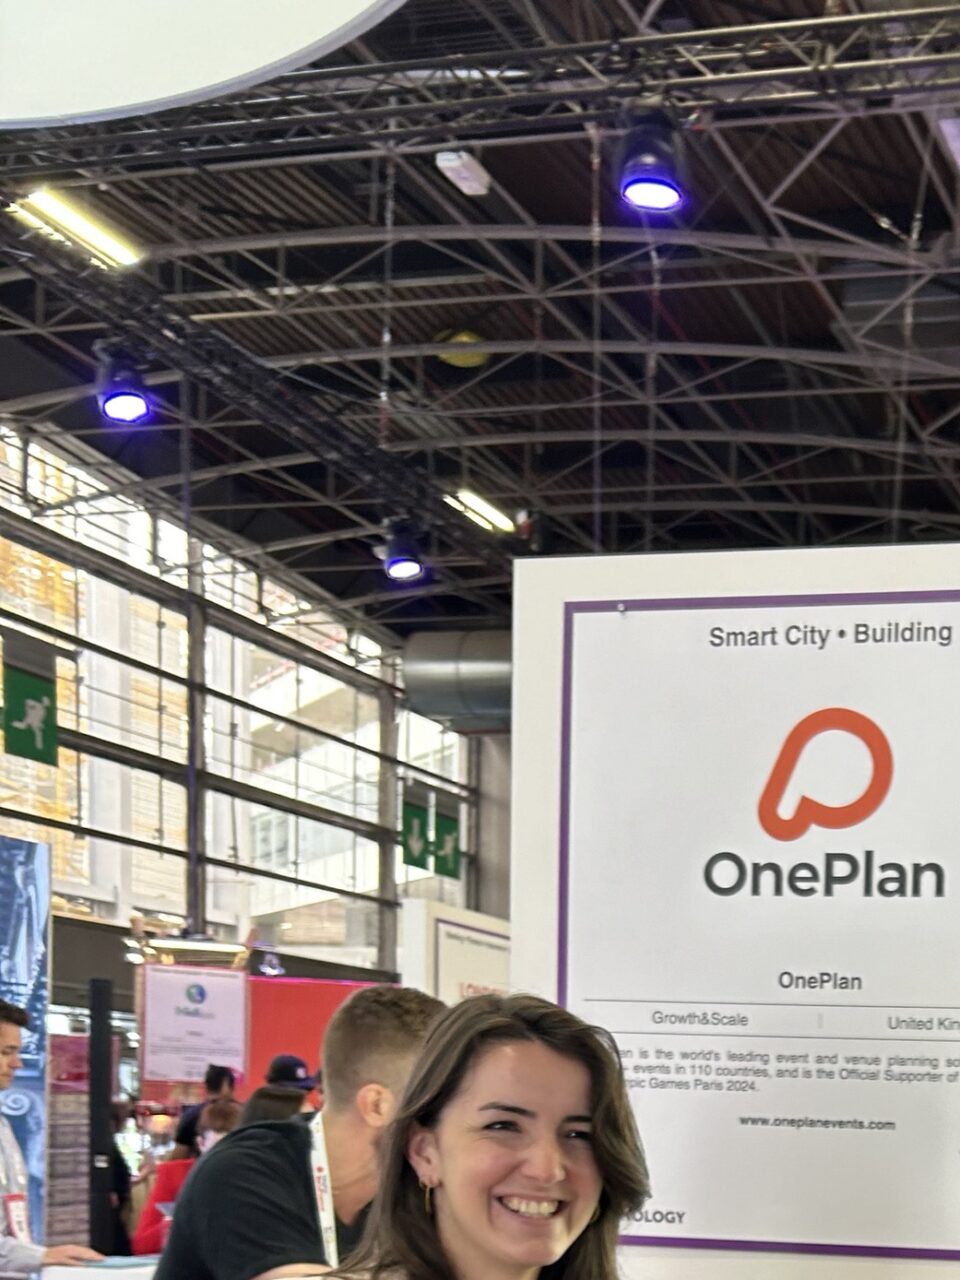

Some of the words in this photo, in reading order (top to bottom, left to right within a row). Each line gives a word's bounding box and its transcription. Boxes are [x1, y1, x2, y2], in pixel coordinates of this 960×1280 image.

[709, 626, 779, 647] Smart
[785, 624, 831, 650] City
[854, 621, 953, 647] Building
[703, 849, 946, 898] OnePlan
[778, 971, 863, 990] OnePlan
[652, 1010, 749, 1027] Growth&Scale
[888, 1017, 934, 1031] United
[639, 1047, 649, 1060] is
[655, 1048, 674, 1061] the
[680, 1049, 721, 1062] world's
[727, 1050, 770, 1065] leading
[776, 1053, 810, 1064] event
[815, 1052, 839, 1065] and
[843, 1055, 881, 1067] venue
[887, 1055, 940, 1070] planning
[633, 1063, 672, 1075] events
[675, 1063, 686, 1075] in
[690, 1064, 713, 1076] 110
[715, 1065, 773, 1079] countries,
[776, 1066, 799, 1079] and
[802, 1067, 813, 1079] is
[815, 1067, 835, 1080] the
[839, 1068, 880, 1081] Official
[884, 1069, 944, 1084] Supporter
[947, 1070, 960, 1083] of
[649, 1077, 691, 1090] Games
[694, 1078, 724, 1091] Paris
[738, 1115, 897, 1131] www.oneplanevents.com
